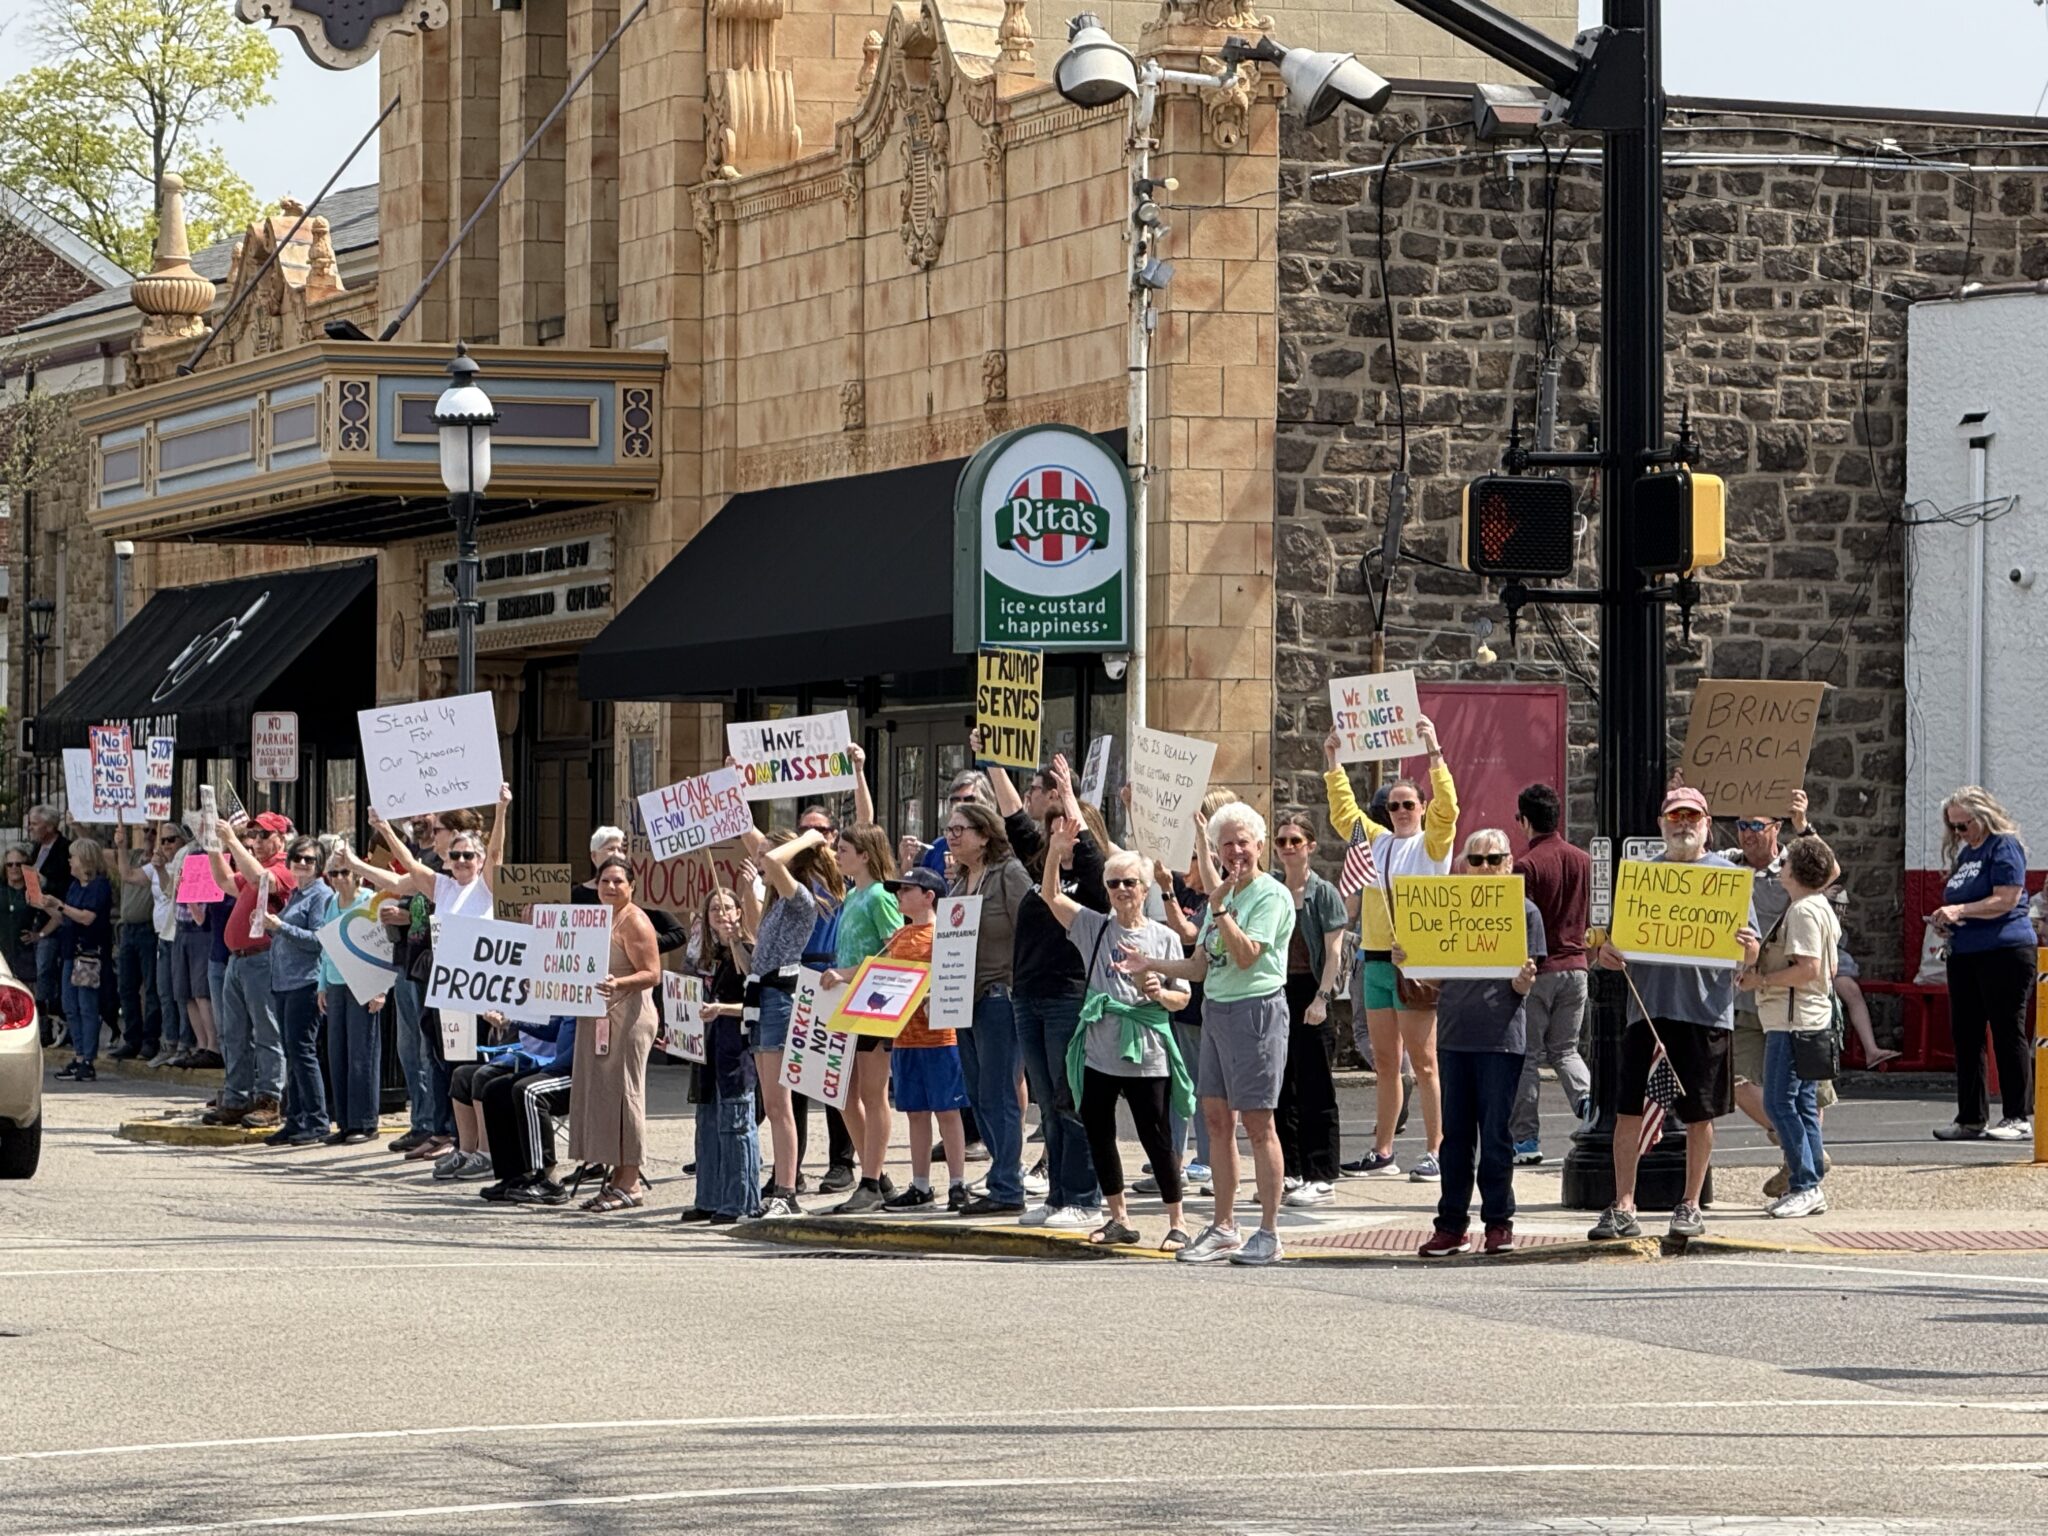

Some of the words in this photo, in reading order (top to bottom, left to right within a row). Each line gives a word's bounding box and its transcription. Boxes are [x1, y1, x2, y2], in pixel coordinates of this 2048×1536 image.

[1011, 497, 1098, 538] Rita's
[1000, 599, 1025, 615] ice
[1039, 597, 1106, 615] custard
[1008, 617, 1100, 637] happiness
[980, 651, 1039, 684] TRUMP
[978, 684, 1039, 721] SERVES
[1707, 692, 1815, 729] BRING
[268, 717, 281, 730] NO
[374, 708, 429, 733] Stand
[438, 705, 455, 726] Up
[1337, 706, 1405, 729] STRONGER
[256, 732, 294, 745] PARKING
[761, 727, 804, 752] HAVE
[979, 723, 1036, 763] PUTIN
[1347, 727, 1414, 752] TOGETHER
[97, 750, 128, 767] KINGS
[1164, 744, 1198, 765] REALLY
[1692, 735, 1802, 767] GARCIA
[151, 763, 171, 779] THE
[380, 756, 403, 772] Our
[419, 766, 438, 779] AND
[1175, 774, 1194, 788] RID
[1699, 779, 1791, 805] HOME
[387, 792, 406, 807] Our
[661, 775, 712, 813] HONK
[1156, 787, 1182, 811] WHY
[651, 817, 664, 837] IF
[665, 811, 685, 831] YOU
[690, 787, 742, 822] NEVER
[655, 825, 706, 856] TEXTED
[714, 805, 745, 827] WAR
[710, 819, 749, 842] PLANS
[501, 866, 525, 884] NO
[530, 867, 571, 883] KINGS
[631, 856, 742, 908] MOCRACY
[1621, 864, 1694, 895] HANDS
[522, 886, 540, 896] IN
[1396, 884, 1461, 908] HANDS
[536, 910, 557, 929] LAW
[560, 911, 568, 927] &
[572, 909, 607, 928] ORDER
[1626, 894, 1661, 920] the
[1409, 911, 1443, 932] Due
[1449, 909, 1512, 932] Process
[556, 931, 576, 950] NOT
[937, 930, 976, 940] DISAPPEARING
[1440, 932, 1458, 952] of
[1467, 933, 1499, 952] LAW
[1635, 922, 1715, 950] STUPID
[473, 936, 527, 966] DUE
[544, 954, 581, 973] CHAOS
[587, 956, 595, 973] &
[431, 965, 531, 1006] PROCES
[535, 980, 593, 1004] DISORDER
[665, 975, 681, 999] WE
[676, 1002, 689, 1022] ALL
[787, 985, 815, 1084] COWORKERS
[810, 1016, 828, 1055] NOT
[823, 1031, 848, 1099] CRIMIN
